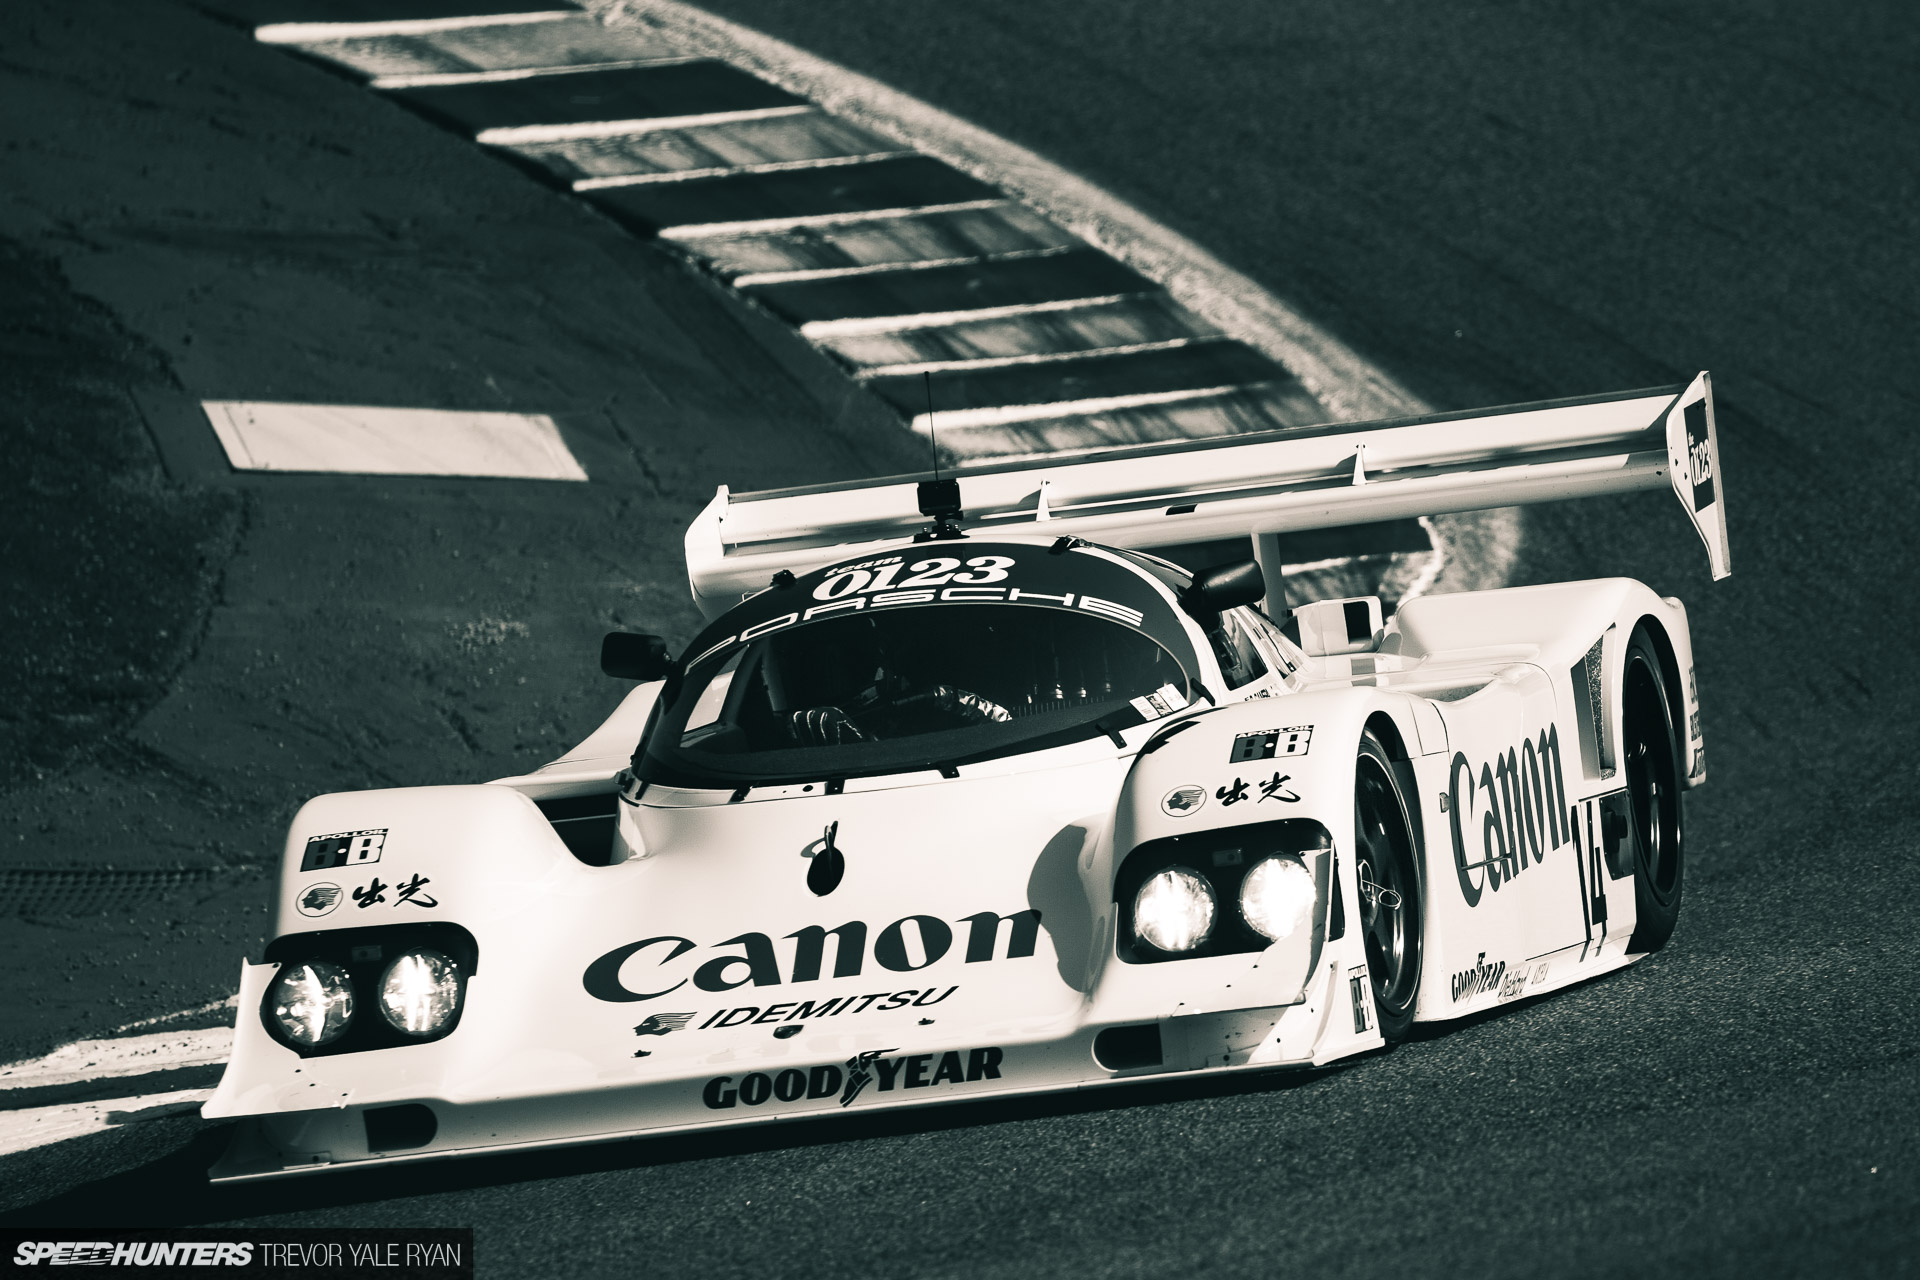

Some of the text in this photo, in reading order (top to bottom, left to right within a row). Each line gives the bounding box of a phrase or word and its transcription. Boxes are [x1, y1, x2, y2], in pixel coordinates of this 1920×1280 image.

[1691, 438, 1712, 487] 0123
[812, 555, 1016, 601] 0123
[824, 556, 903, 578] team
[685, 587, 1144, 675] PORSCHE
[1215, 771, 1302, 807] 出光
[1449, 721, 1571, 908] Canon
[352, 872, 439, 909] 出光
[582, 908, 1043, 1003] Canon
[697, 985, 960, 1031] IDEMITSU
